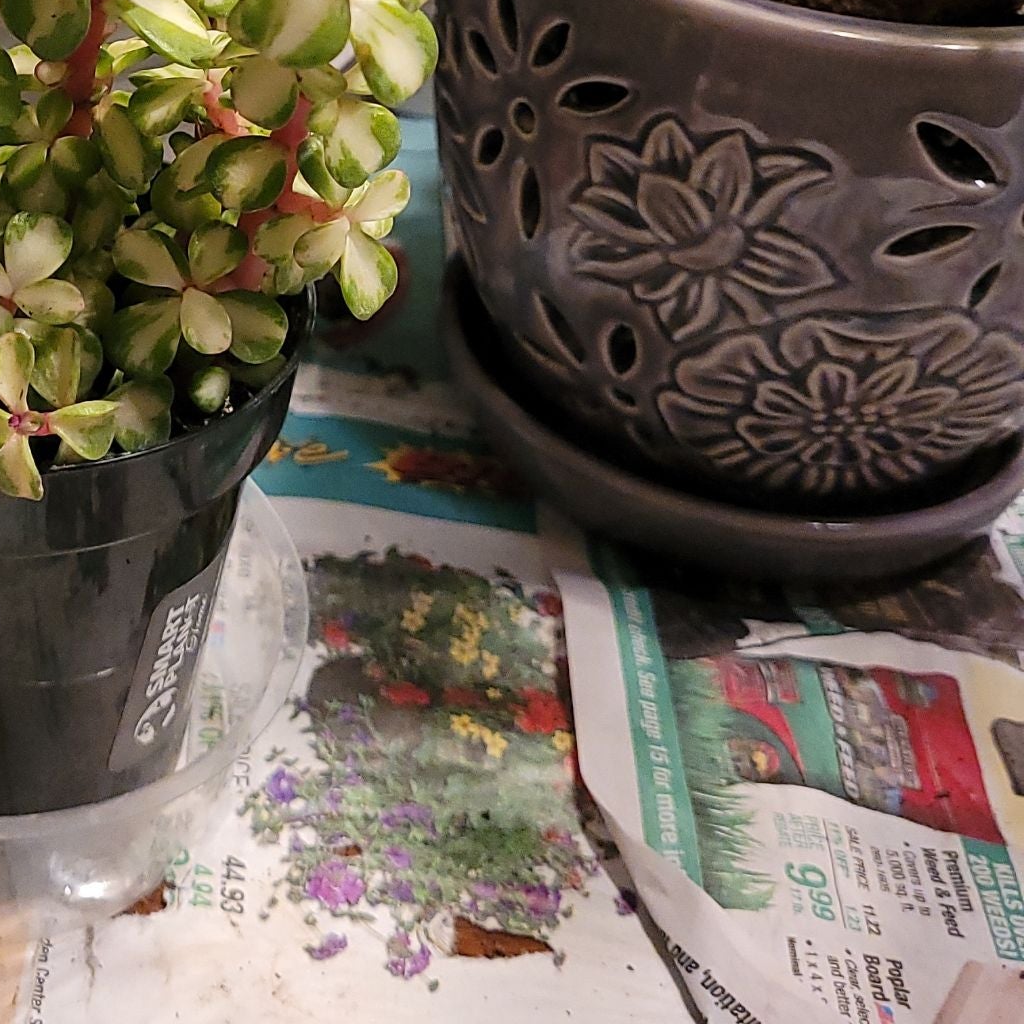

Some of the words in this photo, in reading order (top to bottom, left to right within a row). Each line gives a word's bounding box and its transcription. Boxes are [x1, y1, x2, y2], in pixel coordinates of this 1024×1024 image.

[145, 605, 186, 700] SMART
[638, 670, 656, 698] See
[640, 700, 664, 739] page
[648, 744, 668, 764] 15
[653, 766, 673, 789] for
[656, 792, 680, 843] more
[789, 813, 807, 848] AFTER
[805, 815, 825, 851] PRICE
[845, 825, 862, 854] SALE
[853, 856, 870, 891] PRICE
[903, 851, 921, 885] Covers
[920, 847, 946, 883] Weed
[942, 850, 974, 912] Premium
[968, 853, 994, 885] 200
[220, 854, 247, 915] 44.93
[896, 883, 907, 898] sq.
[914, 889, 926, 902] up
[935, 888, 949, 898] &
[992, 863, 1022, 910] KILLS
[846, 905, 861, 931] 1.23
[862, 905, 881, 935] 11.22
[901, 903, 915, 912] ft.
[919, 906, 931, 916] to
[939, 903, 964, 938] Feed
[979, 891, 1016, 955] WEEDS!
[812, 972, 824, 981] 4
[827, 955, 844, 977] and
[844, 958, 861, 990] Clear,
[862, 954, 890, 1002] Board
[31, 968, 50, 1014] Center
[833, 981, 851, 1018] better
[885, 958, 912, 1010] Poplar
